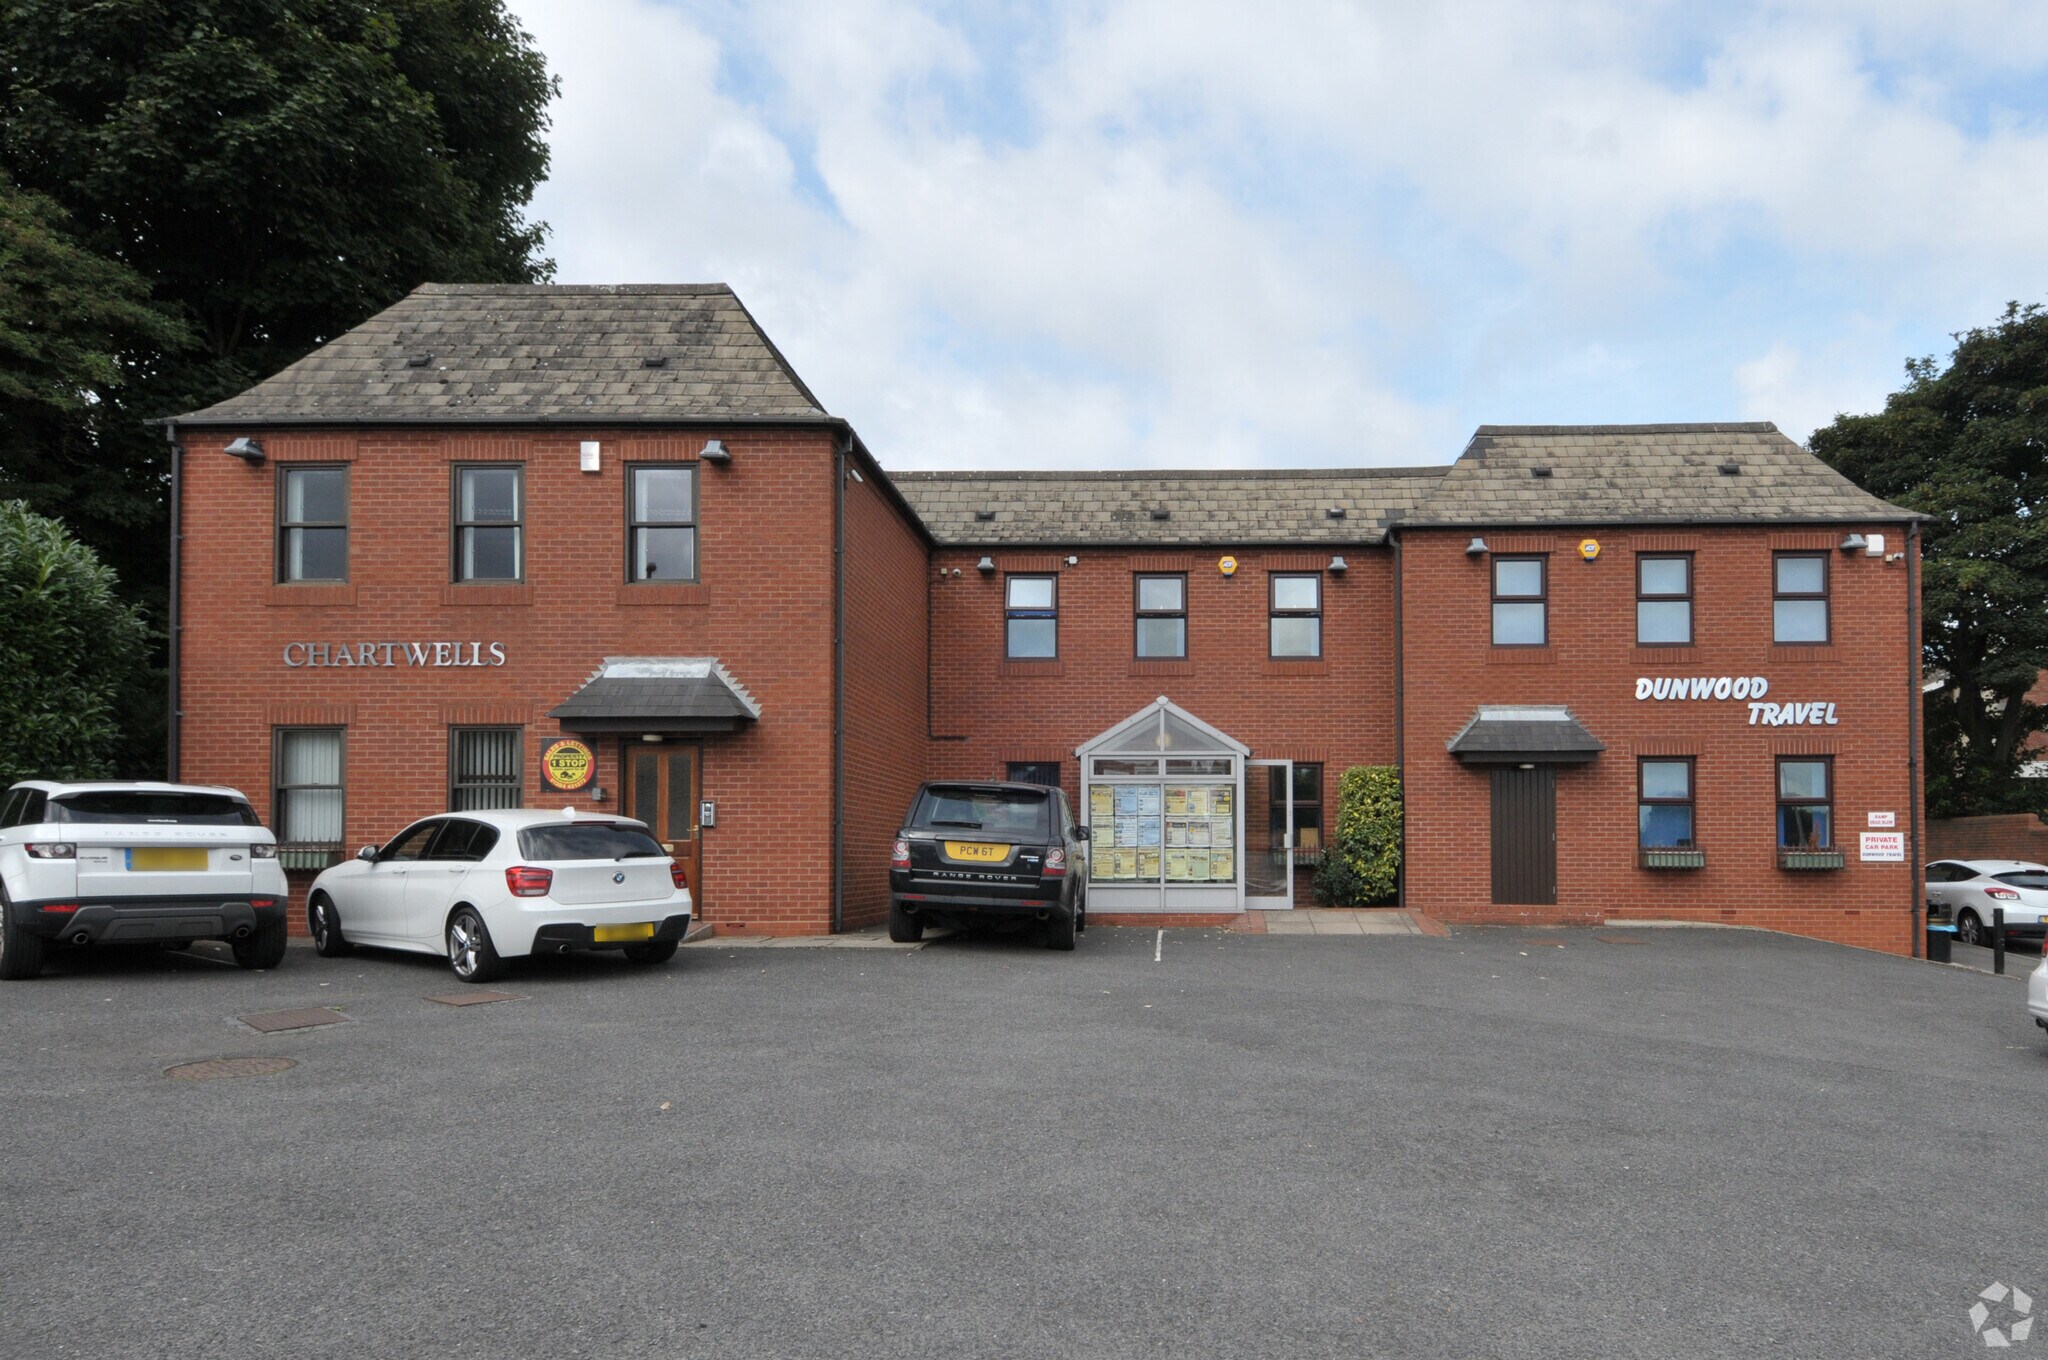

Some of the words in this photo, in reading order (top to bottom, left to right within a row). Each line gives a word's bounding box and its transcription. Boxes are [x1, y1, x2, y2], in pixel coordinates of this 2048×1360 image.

[283, 641, 506, 667] CHARTWELLS
[1635, 676, 1769, 701] DUNWOOD
[1747, 702, 1839, 727] TRAVEL
[960, 846, 979, 856] PCW
[981, 847, 995, 857] 6T
